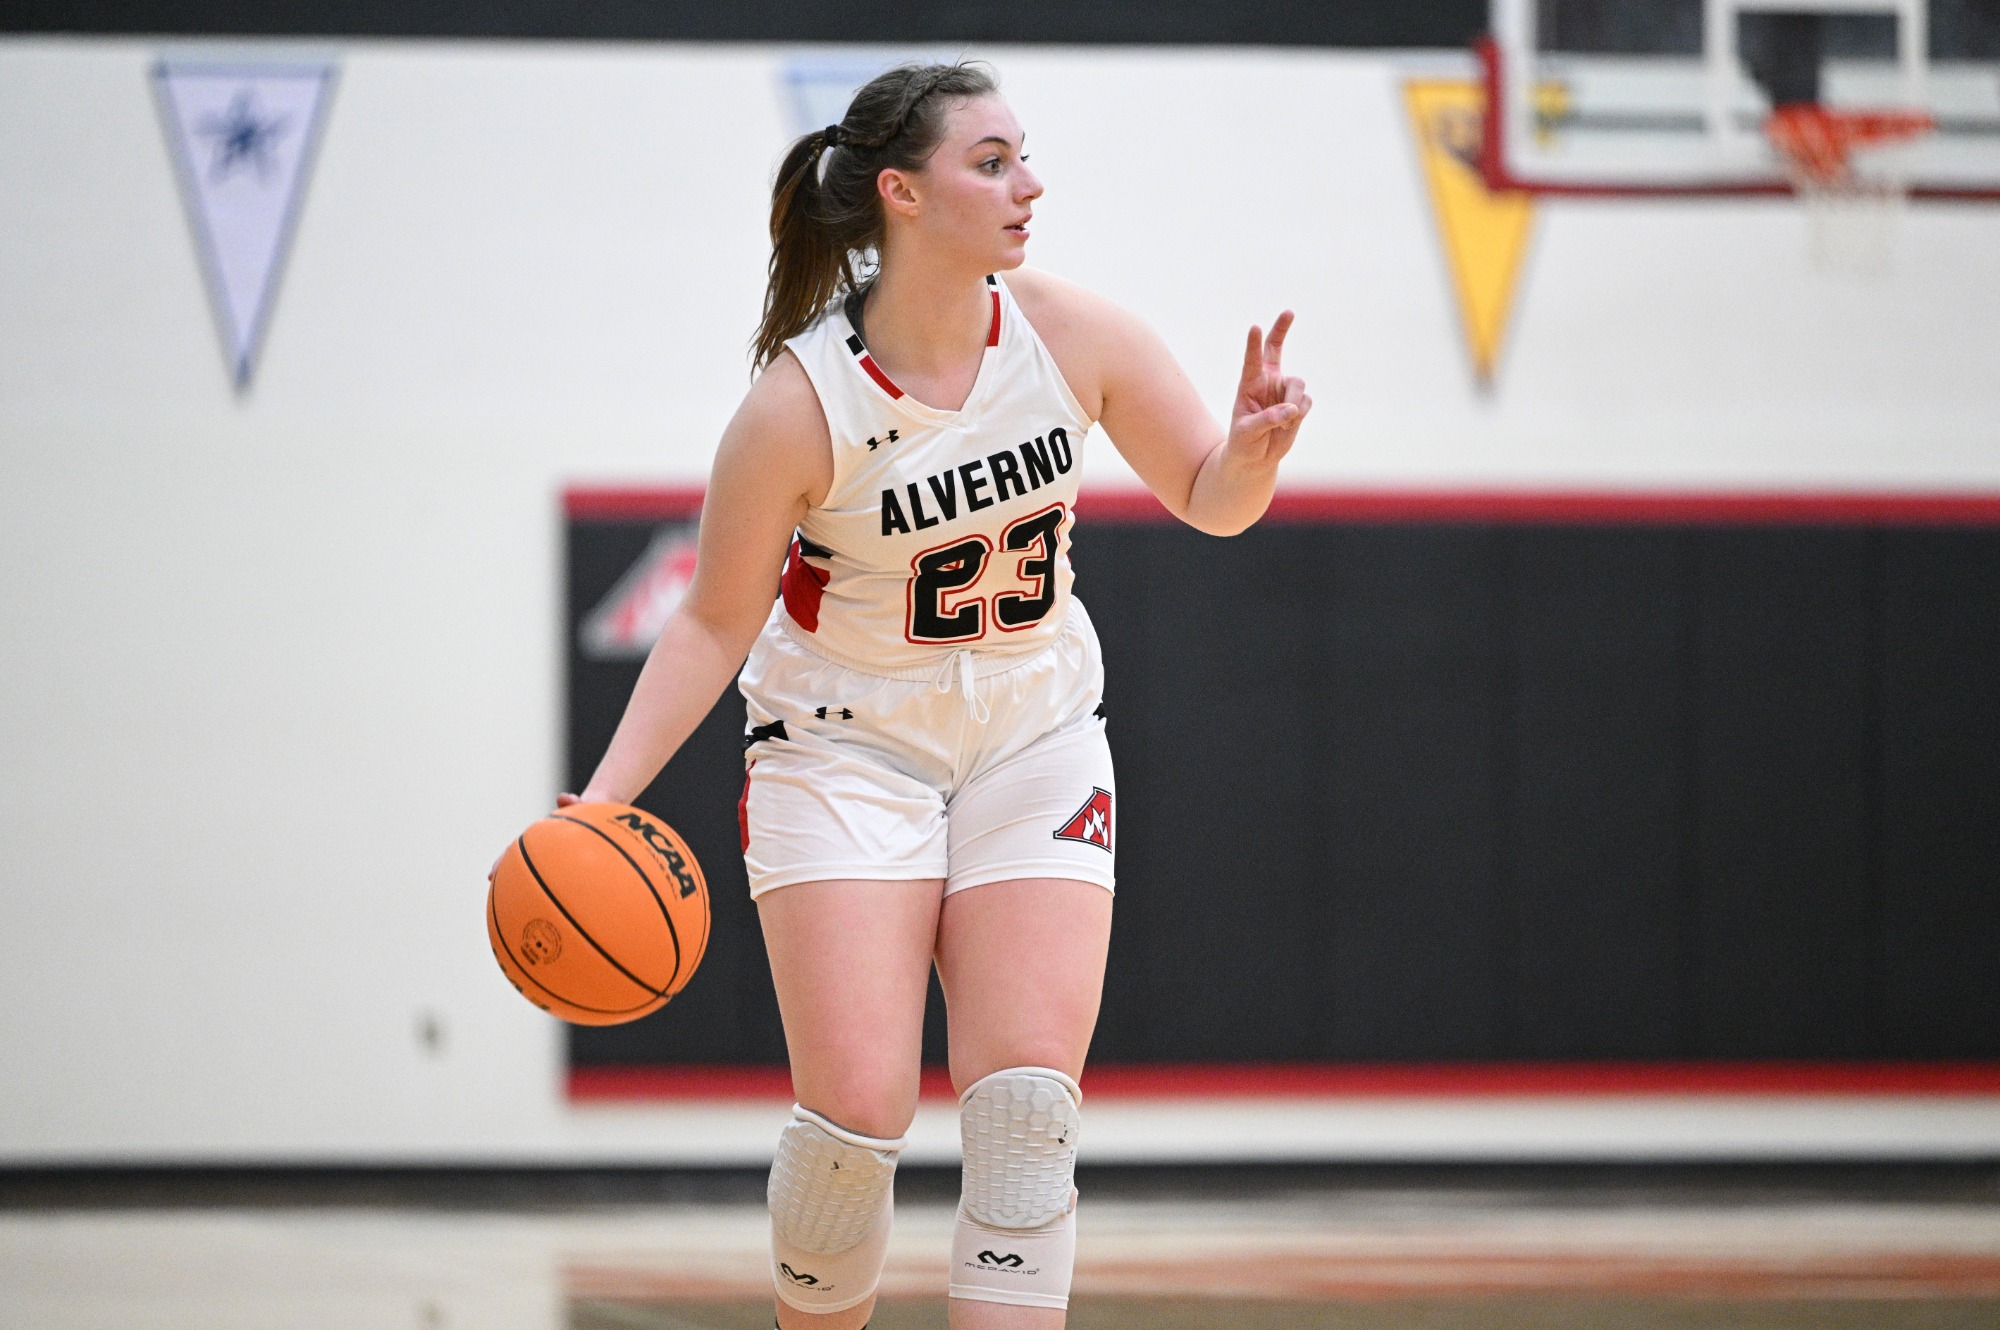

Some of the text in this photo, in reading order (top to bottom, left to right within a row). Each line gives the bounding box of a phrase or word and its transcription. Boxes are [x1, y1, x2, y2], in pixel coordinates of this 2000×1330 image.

[881, 428, 1073, 536] ALVERNO
[905, 502, 1066, 645] 23
[615, 813, 697, 899] NCAA
